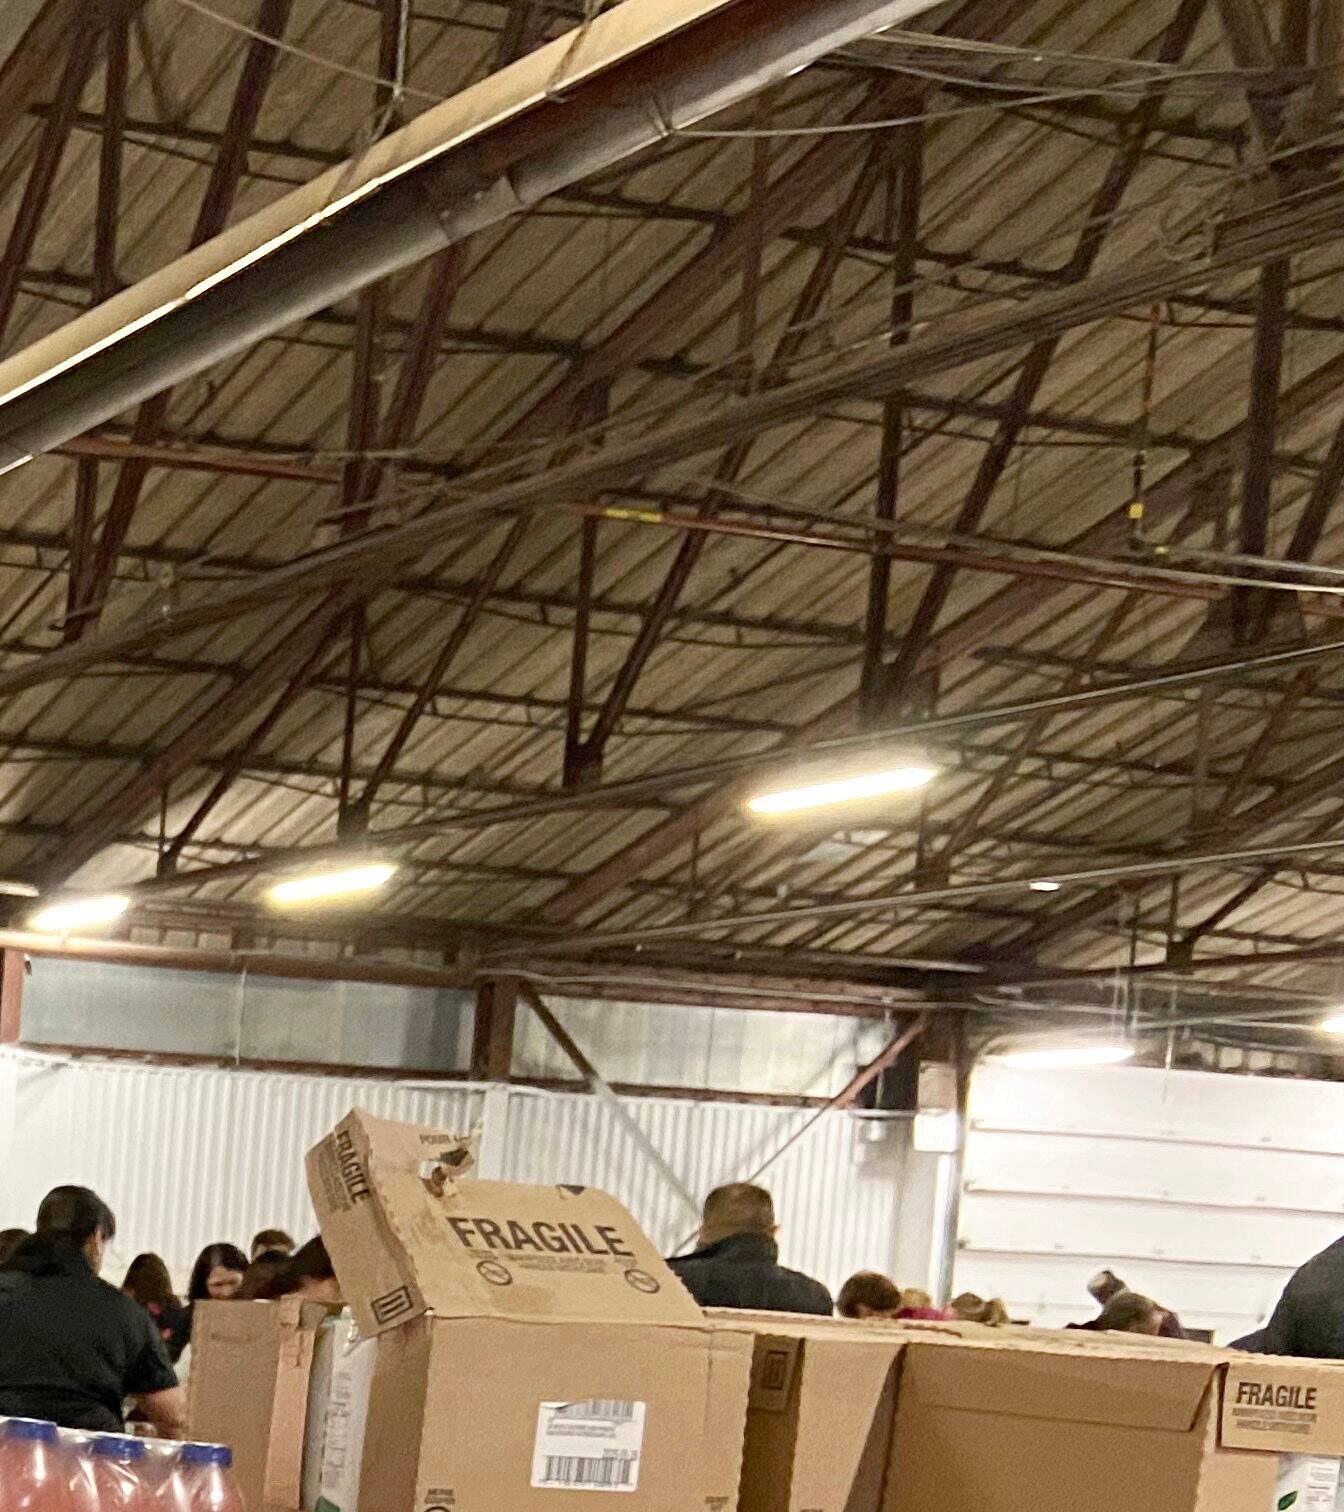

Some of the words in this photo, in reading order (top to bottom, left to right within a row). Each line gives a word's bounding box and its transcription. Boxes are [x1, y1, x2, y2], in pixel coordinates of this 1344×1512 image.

[336, 1130, 371, 1204] FRAGILE
[446, 1216, 636, 1257] FRAGILE
[1235, 1381, 1318, 1410] FRAGILE
